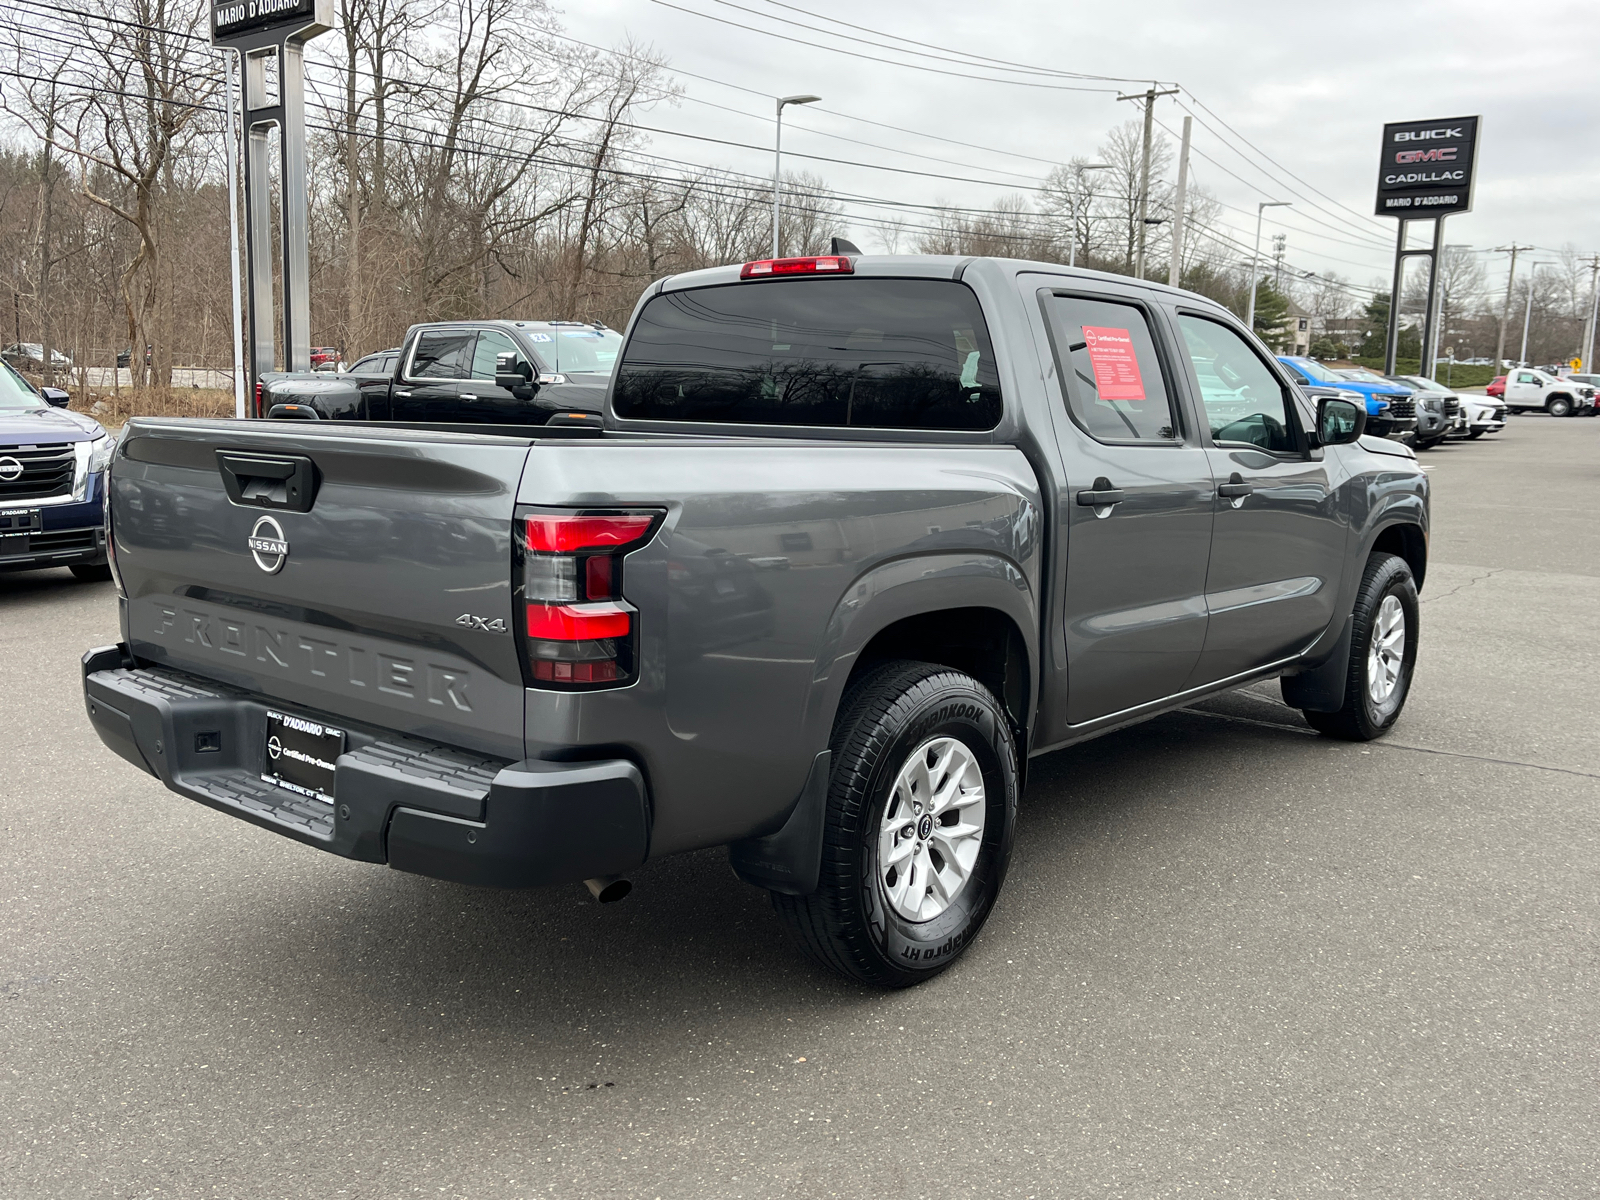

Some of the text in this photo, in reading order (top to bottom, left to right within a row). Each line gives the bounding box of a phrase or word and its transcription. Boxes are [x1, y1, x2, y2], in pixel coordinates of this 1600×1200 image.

[217, 4, 245, 26] MARIO
[1394, 127, 1463, 141] BUICK
[1395, 147, 1458, 164] GMC
[1385, 170, 1464, 184] CADILLAC
[1385, 195, 1458, 207] MARIO D'ADDARIO
[248, 538, 287, 553] NISSAN
[152, 602, 472, 712] FRONTIER
[267, 711, 341, 738] BUICK D'ADDARIO GMC
[282, 747, 306, 762] Certified
[305, 754, 336, 771] Pre-Owne
